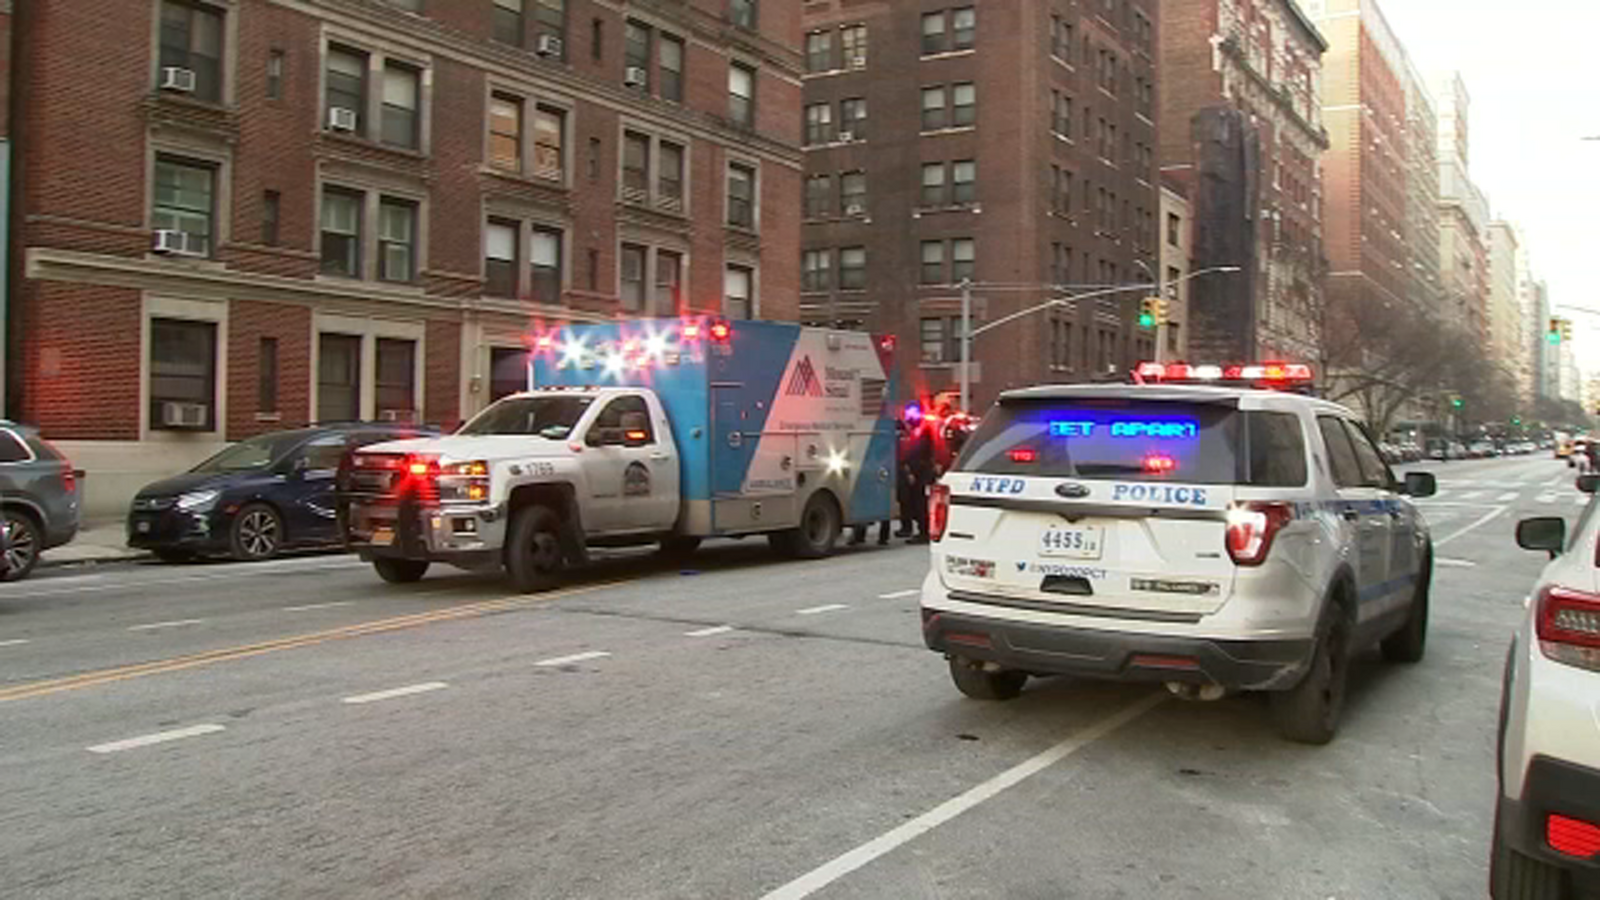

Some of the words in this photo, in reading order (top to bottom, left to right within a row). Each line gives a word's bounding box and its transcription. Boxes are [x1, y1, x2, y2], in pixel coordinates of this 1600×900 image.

[970, 477, 1025, 494] NYPD
[1112, 483, 1207, 505] POLICE
[1042, 531, 1083, 549] 4455
